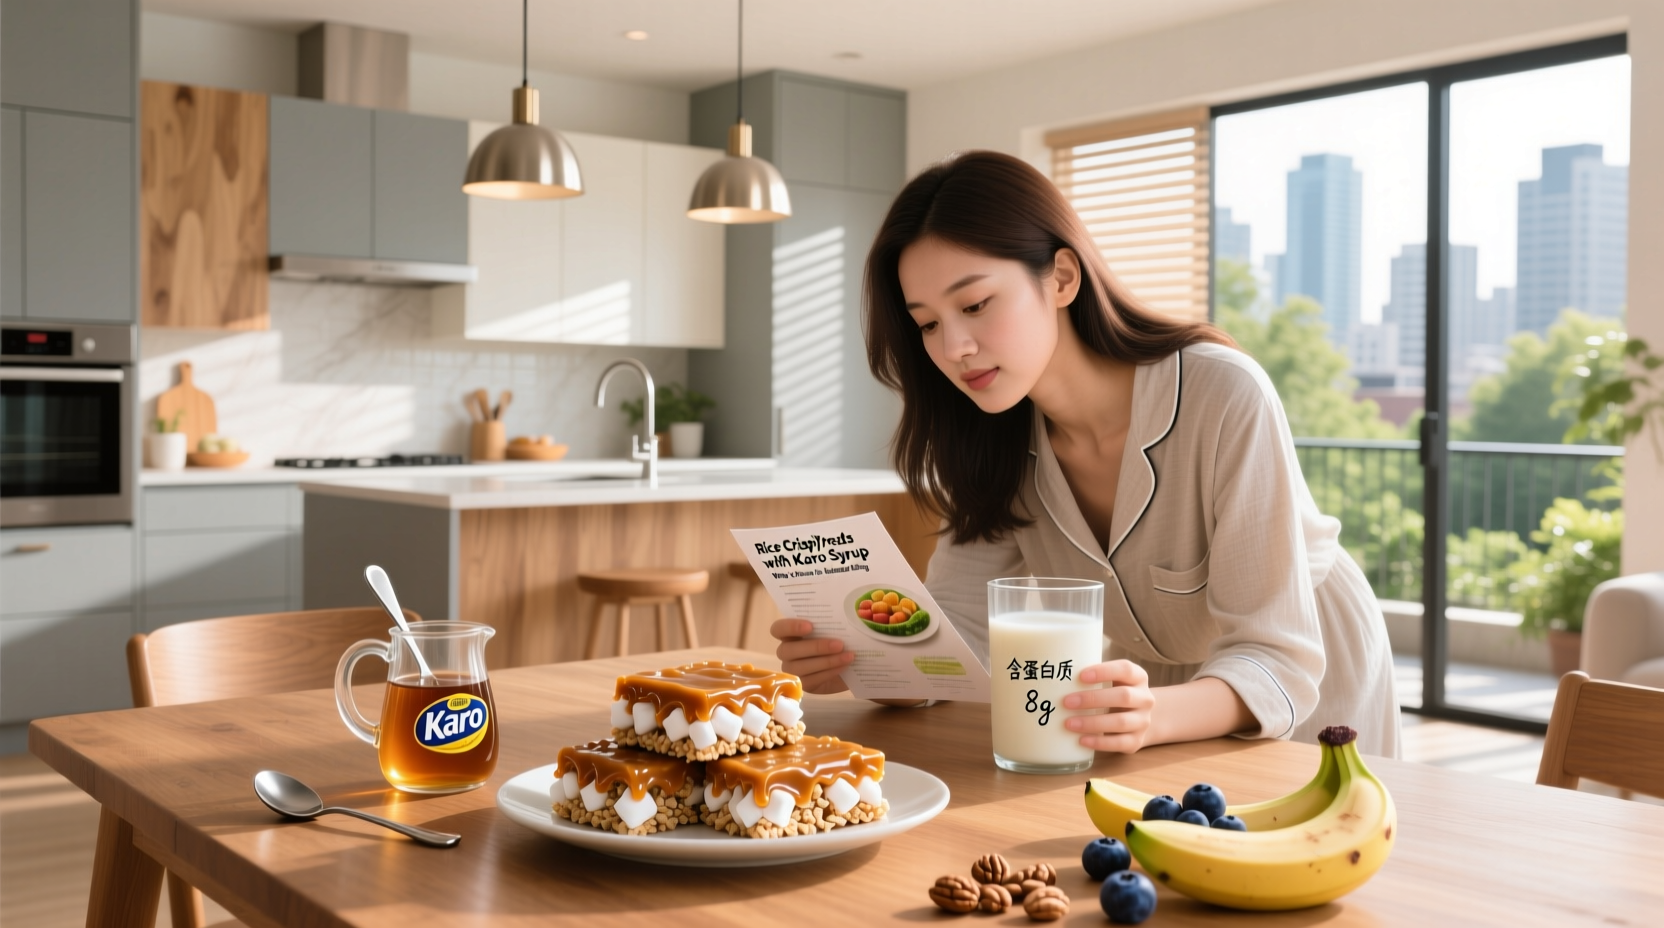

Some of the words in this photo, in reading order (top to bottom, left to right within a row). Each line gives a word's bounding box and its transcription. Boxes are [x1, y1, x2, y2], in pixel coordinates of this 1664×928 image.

[754, 541, 781, 555] Rice
[792, 552, 827, 566] Karo
[828, 548, 869, 565] Syrup
[1006, 657, 1073, 681] 含蛋白质
[1025, 689, 1056, 726] 8g
[424, 707, 483, 741] Karo
